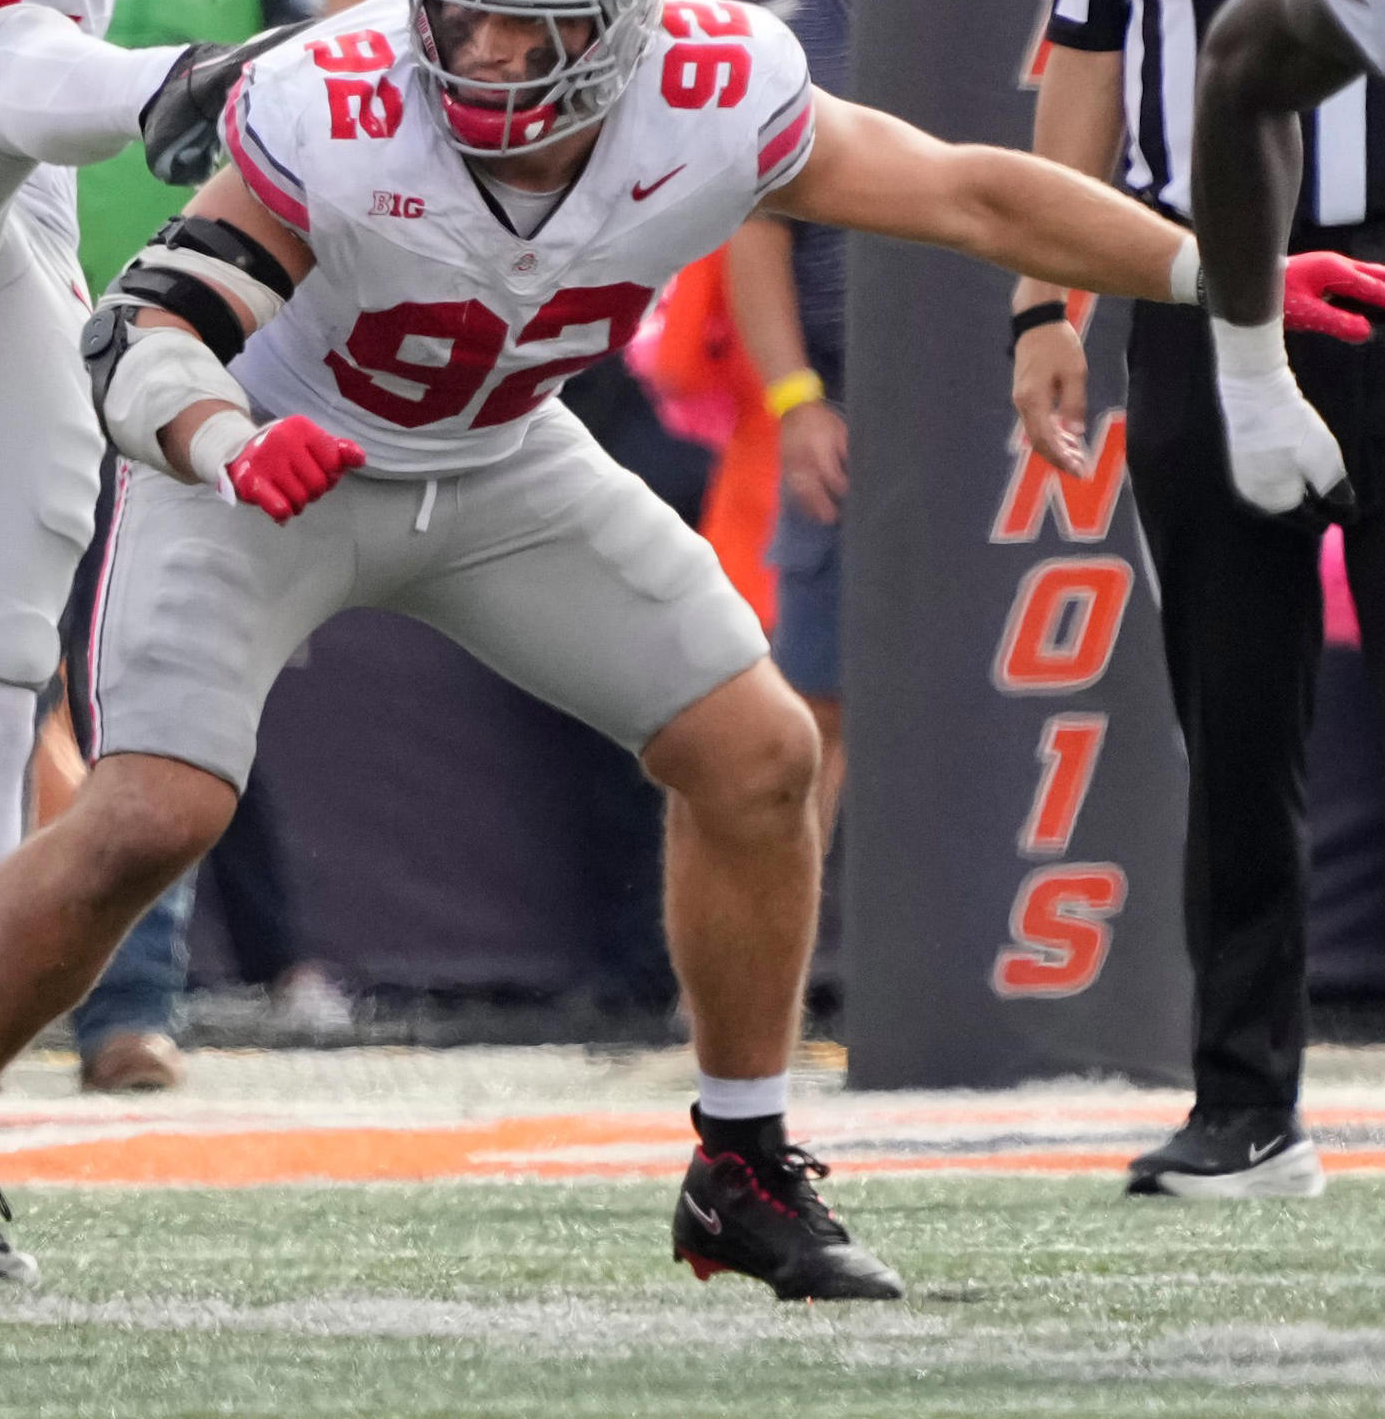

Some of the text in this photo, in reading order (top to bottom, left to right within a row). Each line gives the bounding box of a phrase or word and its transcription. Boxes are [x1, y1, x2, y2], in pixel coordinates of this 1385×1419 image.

[303, 28, 405, 141] 92
[660, 0, 755, 110] 92
[322, 280, 656, 431] 92
